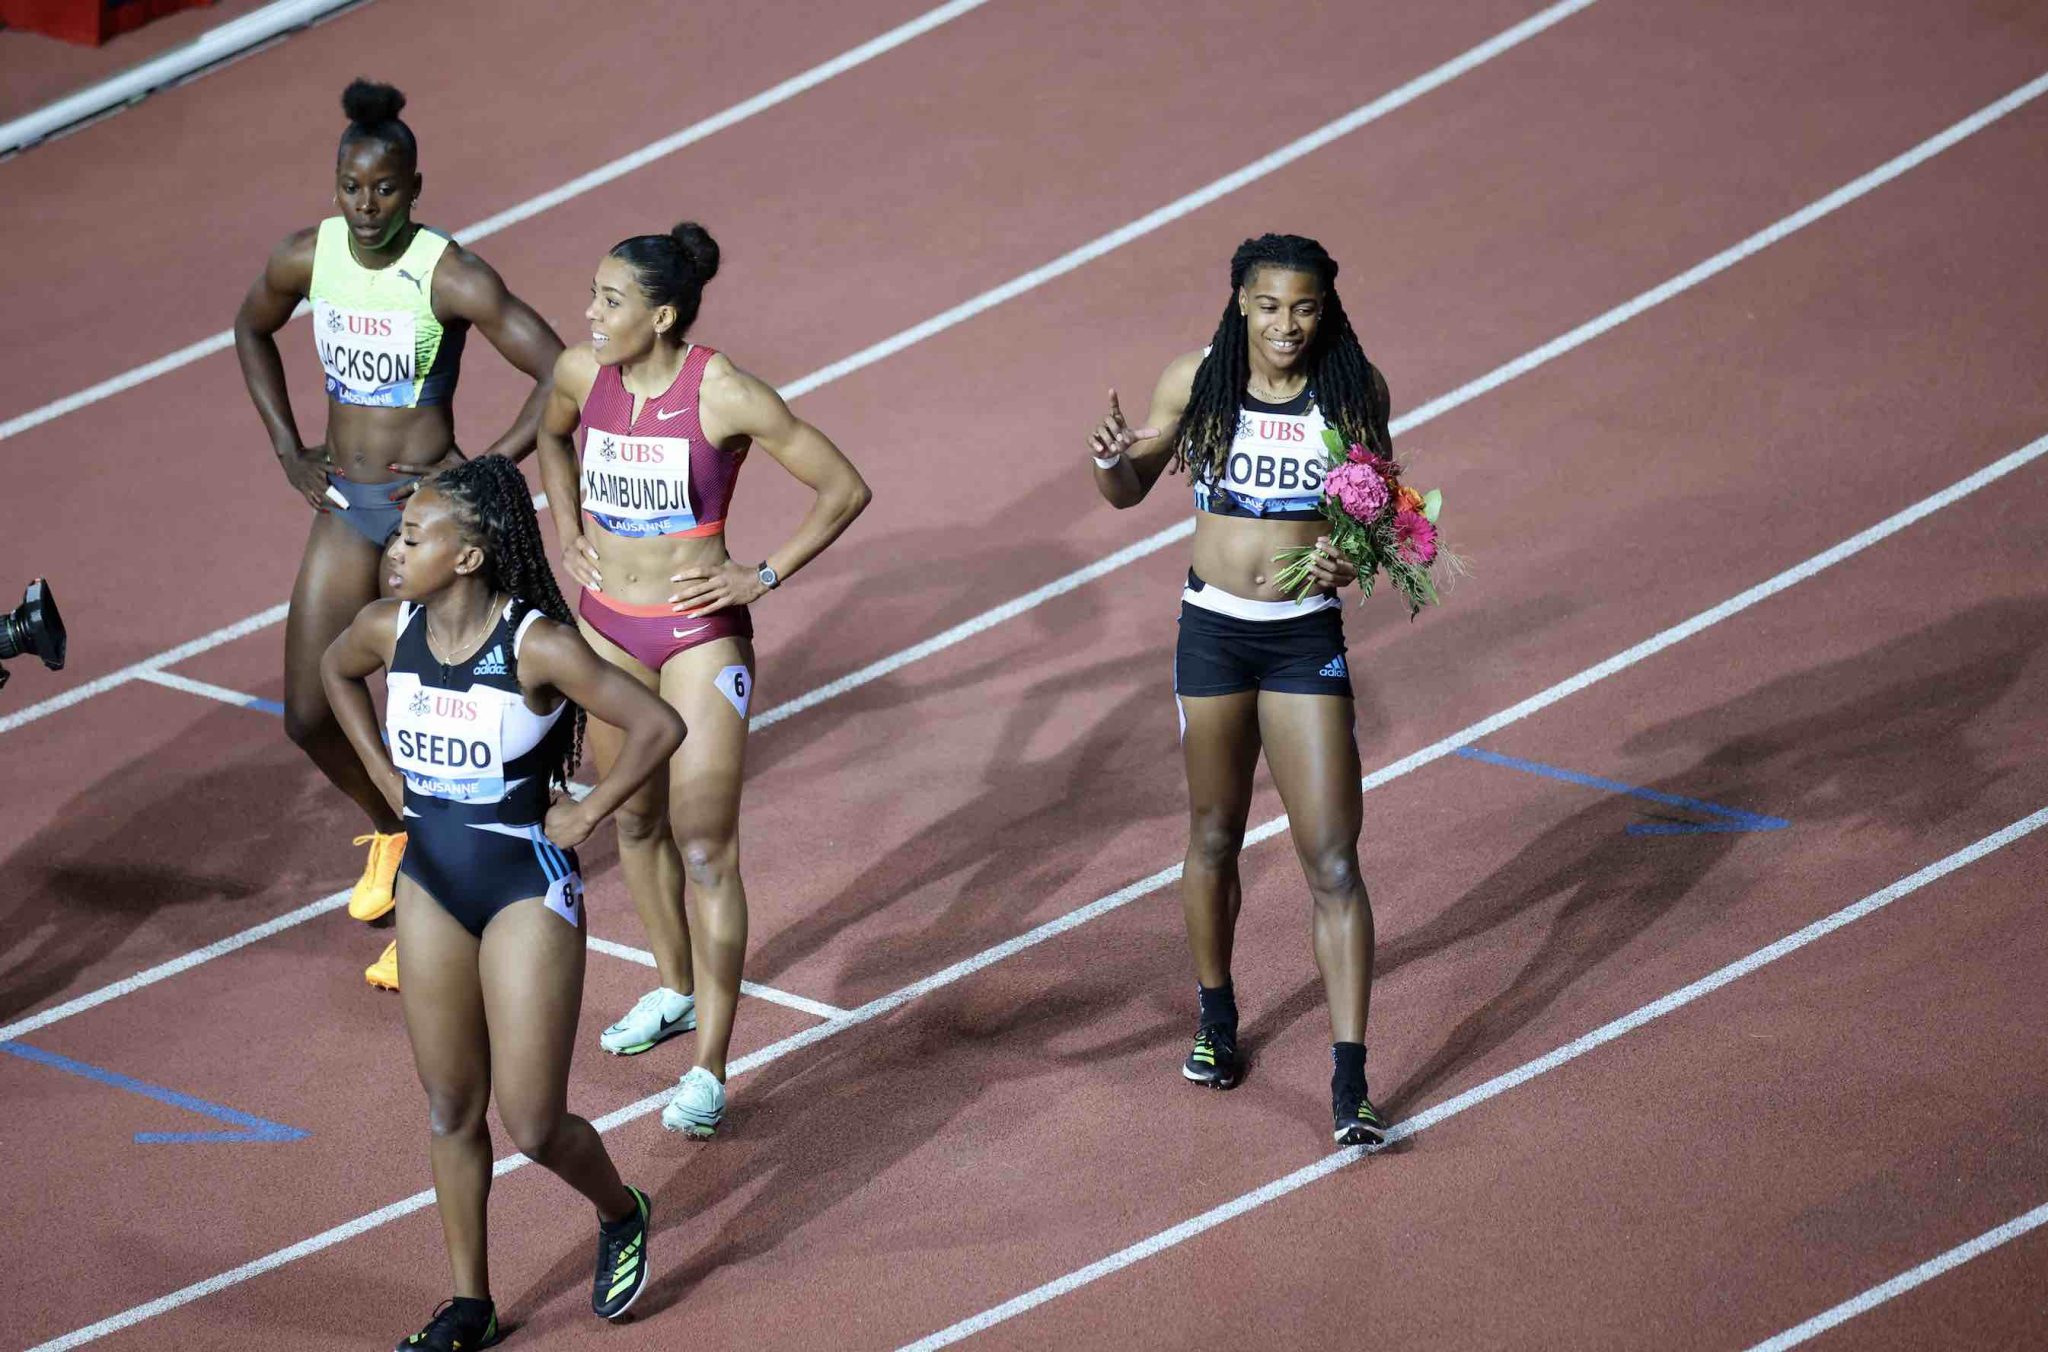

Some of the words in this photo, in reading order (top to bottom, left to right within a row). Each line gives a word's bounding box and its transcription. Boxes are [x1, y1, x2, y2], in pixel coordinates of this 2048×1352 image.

[348, 315, 392, 336] UBS
[1260, 420, 1305, 442] UBS
[621, 442, 664, 463] UBS
[1230, 452, 1322, 490] OBBS
[587, 470, 686, 510] KAMBUNDJI
[608, 519, 672, 532] LAUSANNE
[734, 672, 745, 698] 6
[436, 697, 477, 721] UBS
[398, 729, 491, 769] SEEDO
[415, 777, 480, 794] LAUSANNE
